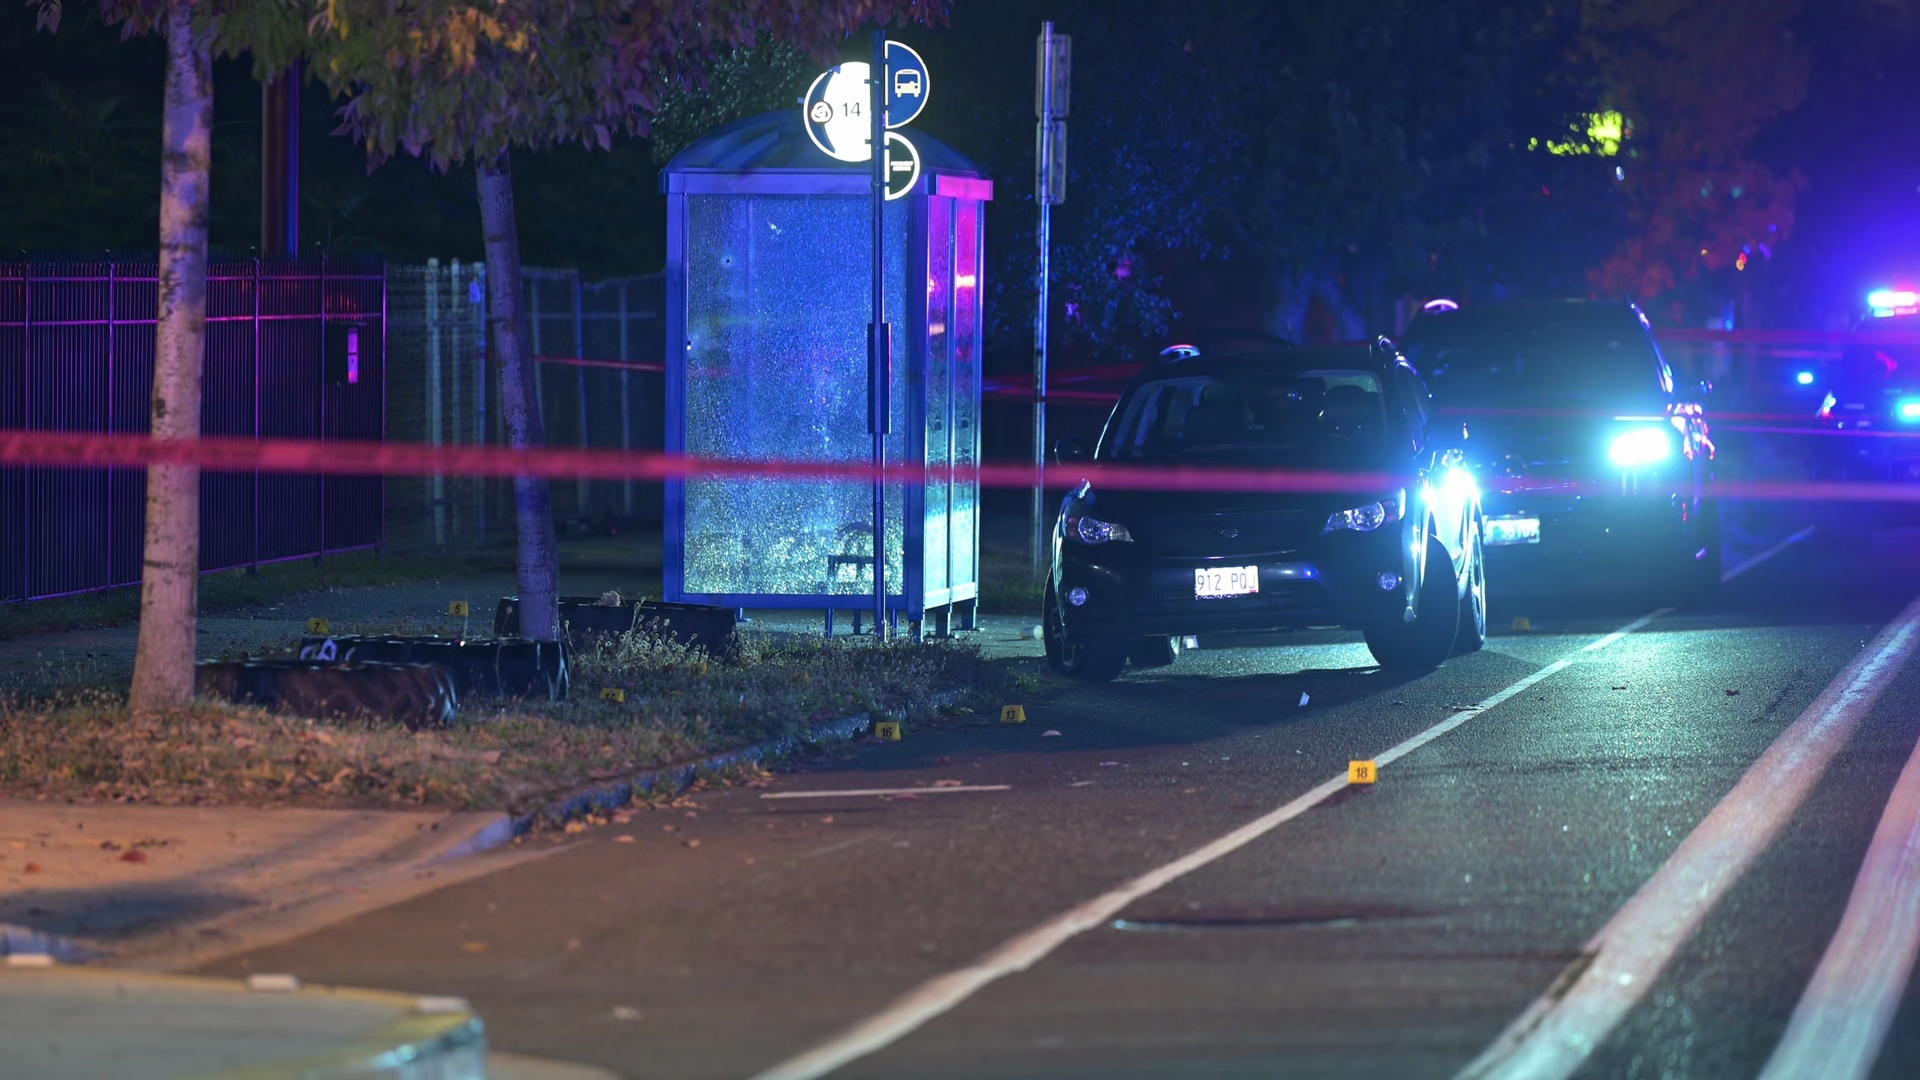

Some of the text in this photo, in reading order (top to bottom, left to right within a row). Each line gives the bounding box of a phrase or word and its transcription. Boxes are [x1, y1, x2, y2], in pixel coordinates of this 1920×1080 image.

[842, 102, 861, 117] 14
[1197, 573, 1256, 591] 912 PQJ
[314, 622, 320, 631] 7
[1005, 710, 1016, 720] 13
[881, 727, 892, 738] 16
[1355, 767, 1368, 779] 18
